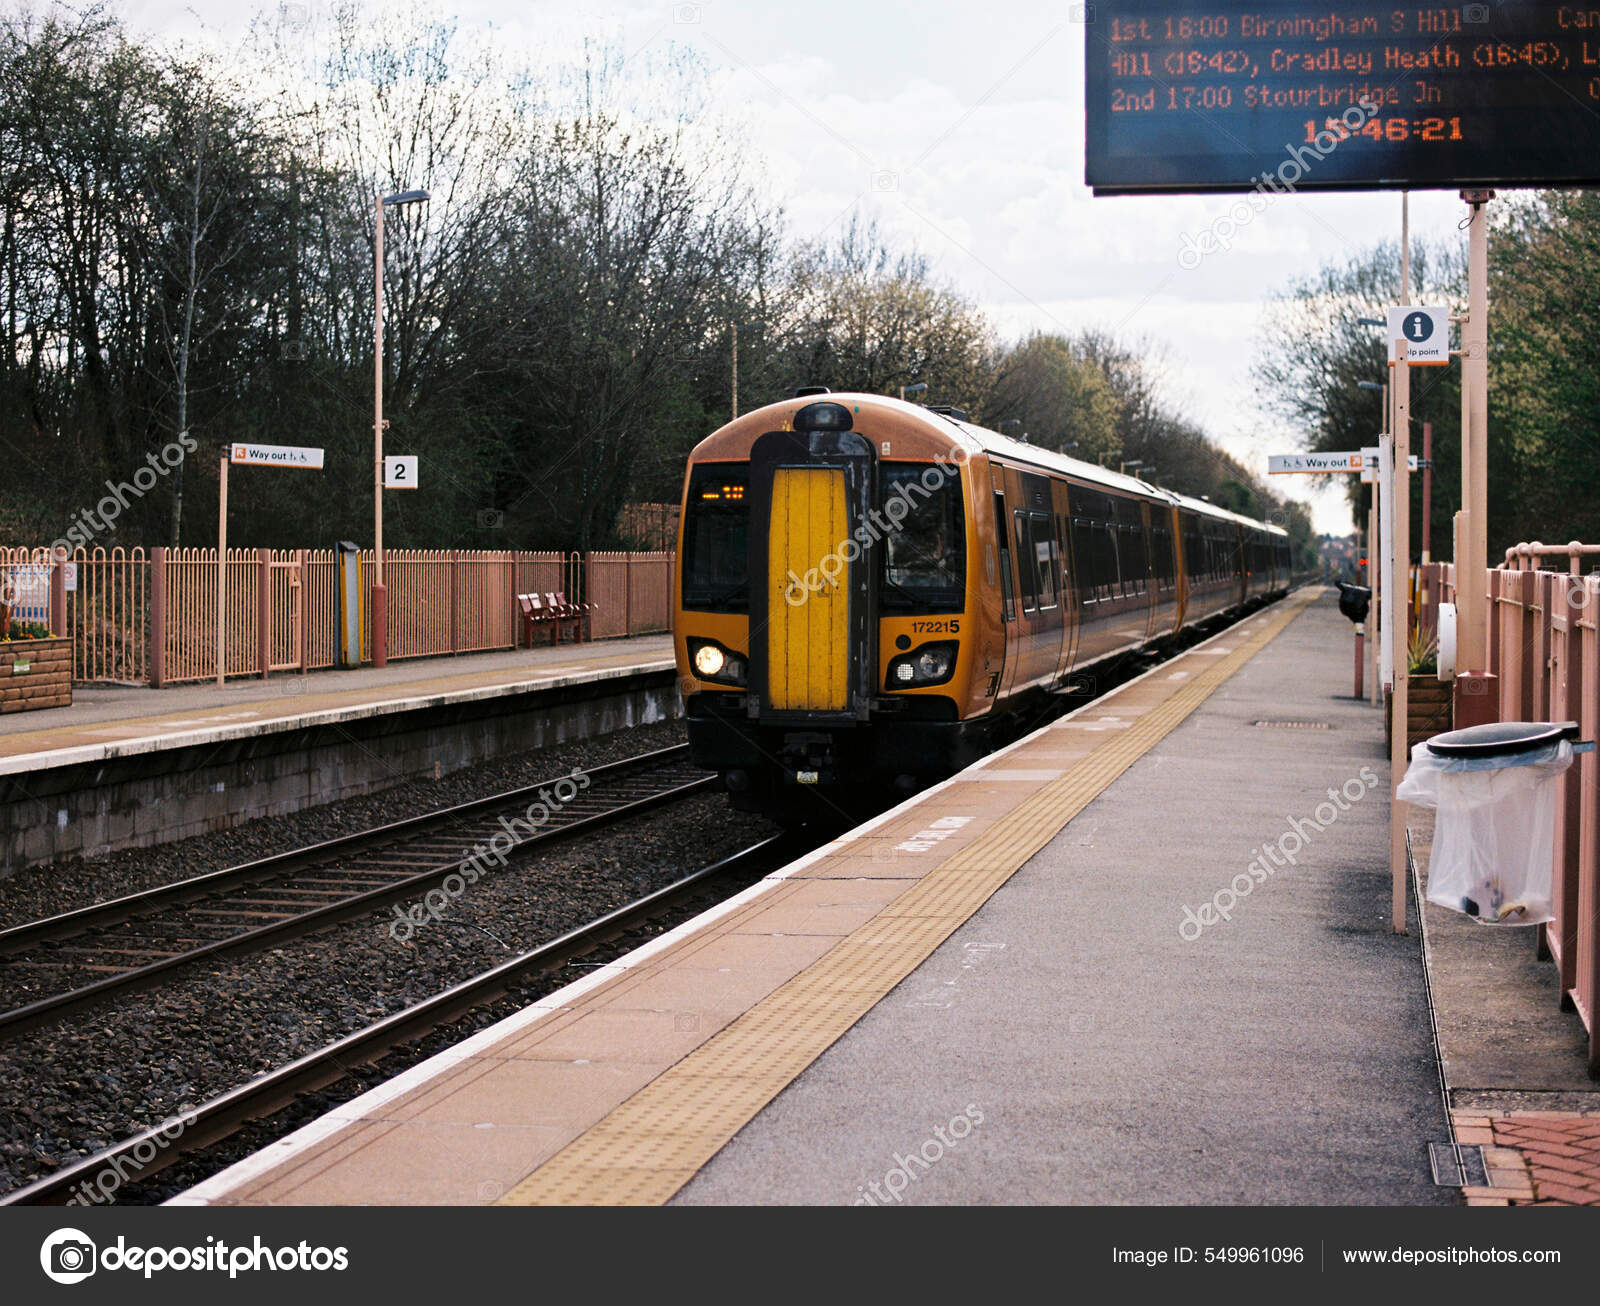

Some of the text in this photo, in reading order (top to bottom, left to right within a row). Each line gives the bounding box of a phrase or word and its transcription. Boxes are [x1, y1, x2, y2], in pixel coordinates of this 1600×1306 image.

[1111, 17, 1152, 41] 1st
[1241, 12, 1378, 41] Birmingham
[1391, 9, 1405, 33] S
[1417, 9, 1461, 33] Hill
[1270, 47, 1372, 75] Cradley
[1384, 45, 1460, 69] Heath
[1111, 80, 1441, 111] 2nd 17:00 Stourbridge Jn
[1419, 348, 1439, 356] point
[249, 449, 287, 461] Way out
[1306, 458, 1347, 468] Way out
[394, 463, 406, 480] 2
[912, 619, 960, 633] 172215
